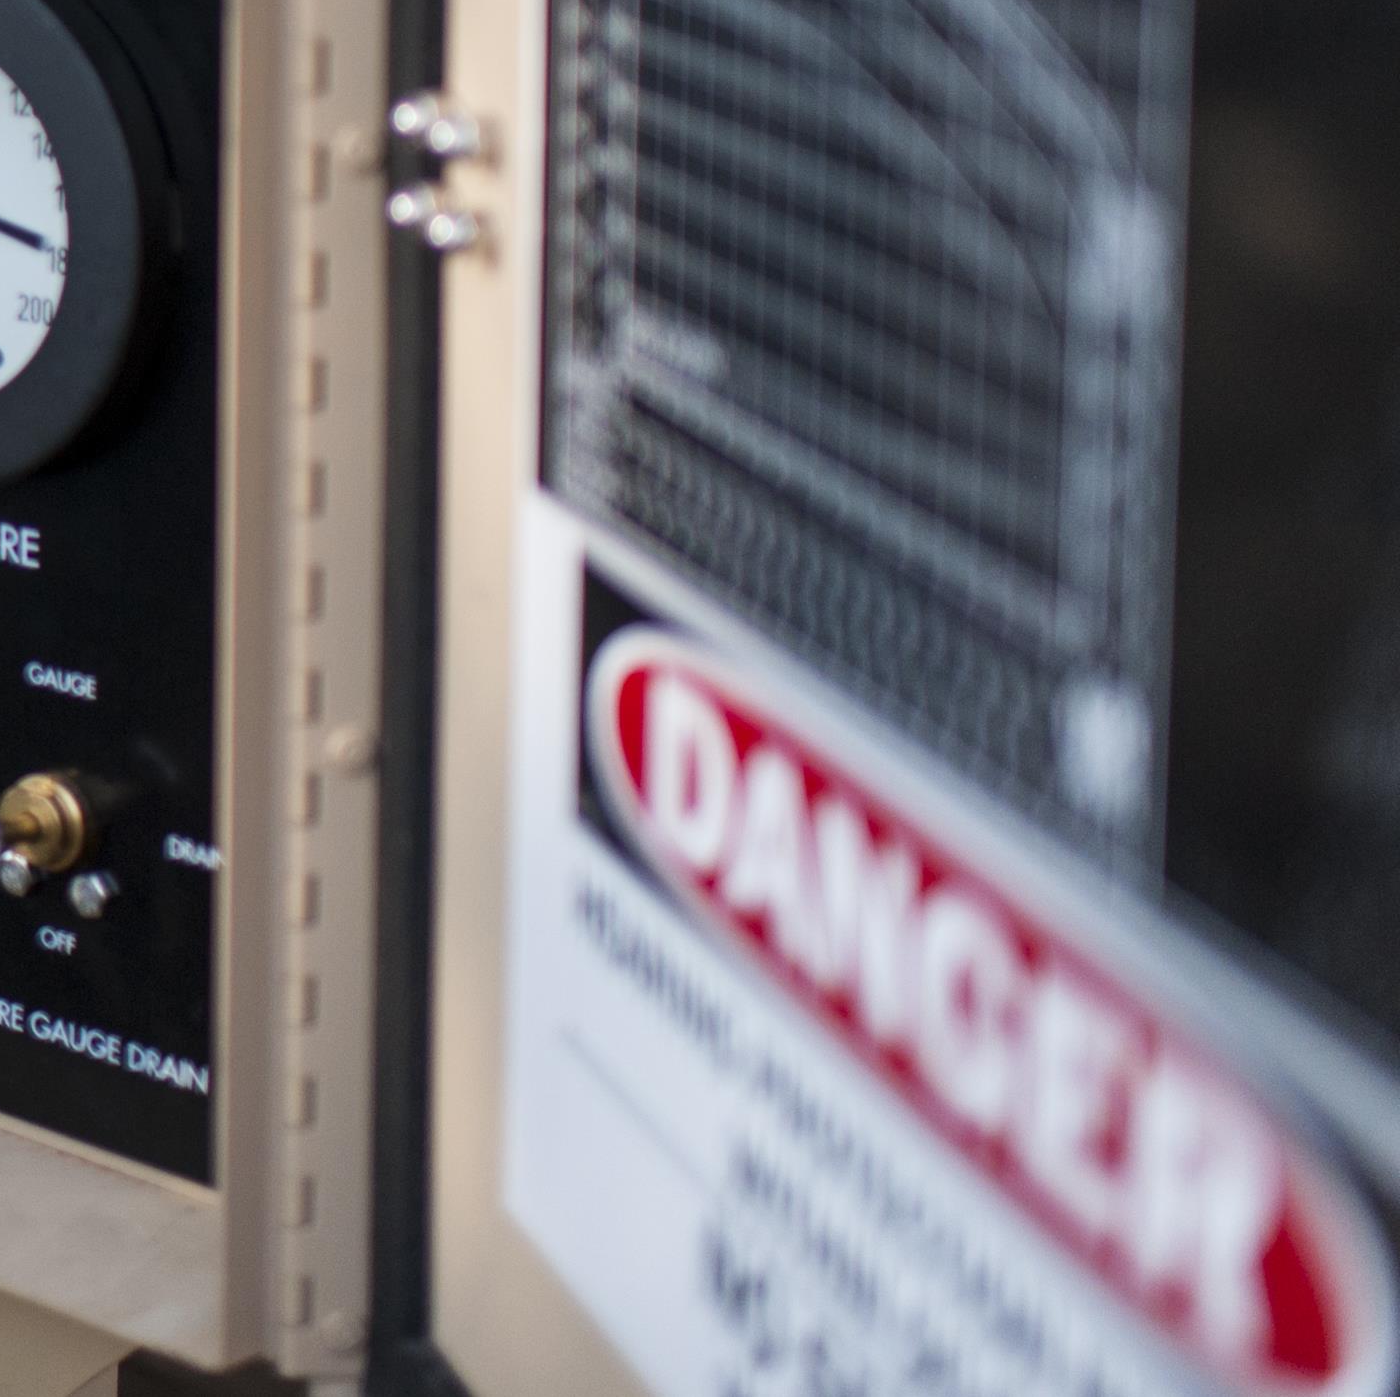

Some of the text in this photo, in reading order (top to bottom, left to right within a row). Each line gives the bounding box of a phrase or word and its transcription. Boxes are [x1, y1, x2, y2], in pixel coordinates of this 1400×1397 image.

[10, 86, 34, 117] 12
[33, 132, 53, 159] 14
[48, 246, 68, 275] 18
[17, 295, 53, 326] 200
[24, 661, 97, 700] GAUGE
[37, 925, 77, 955] OFF
[640, 670, 1282, 1356] DANGER
[30, 1010, 120, 1065] GAUGE
[127, 1041, 209, 1094] DRAIN
